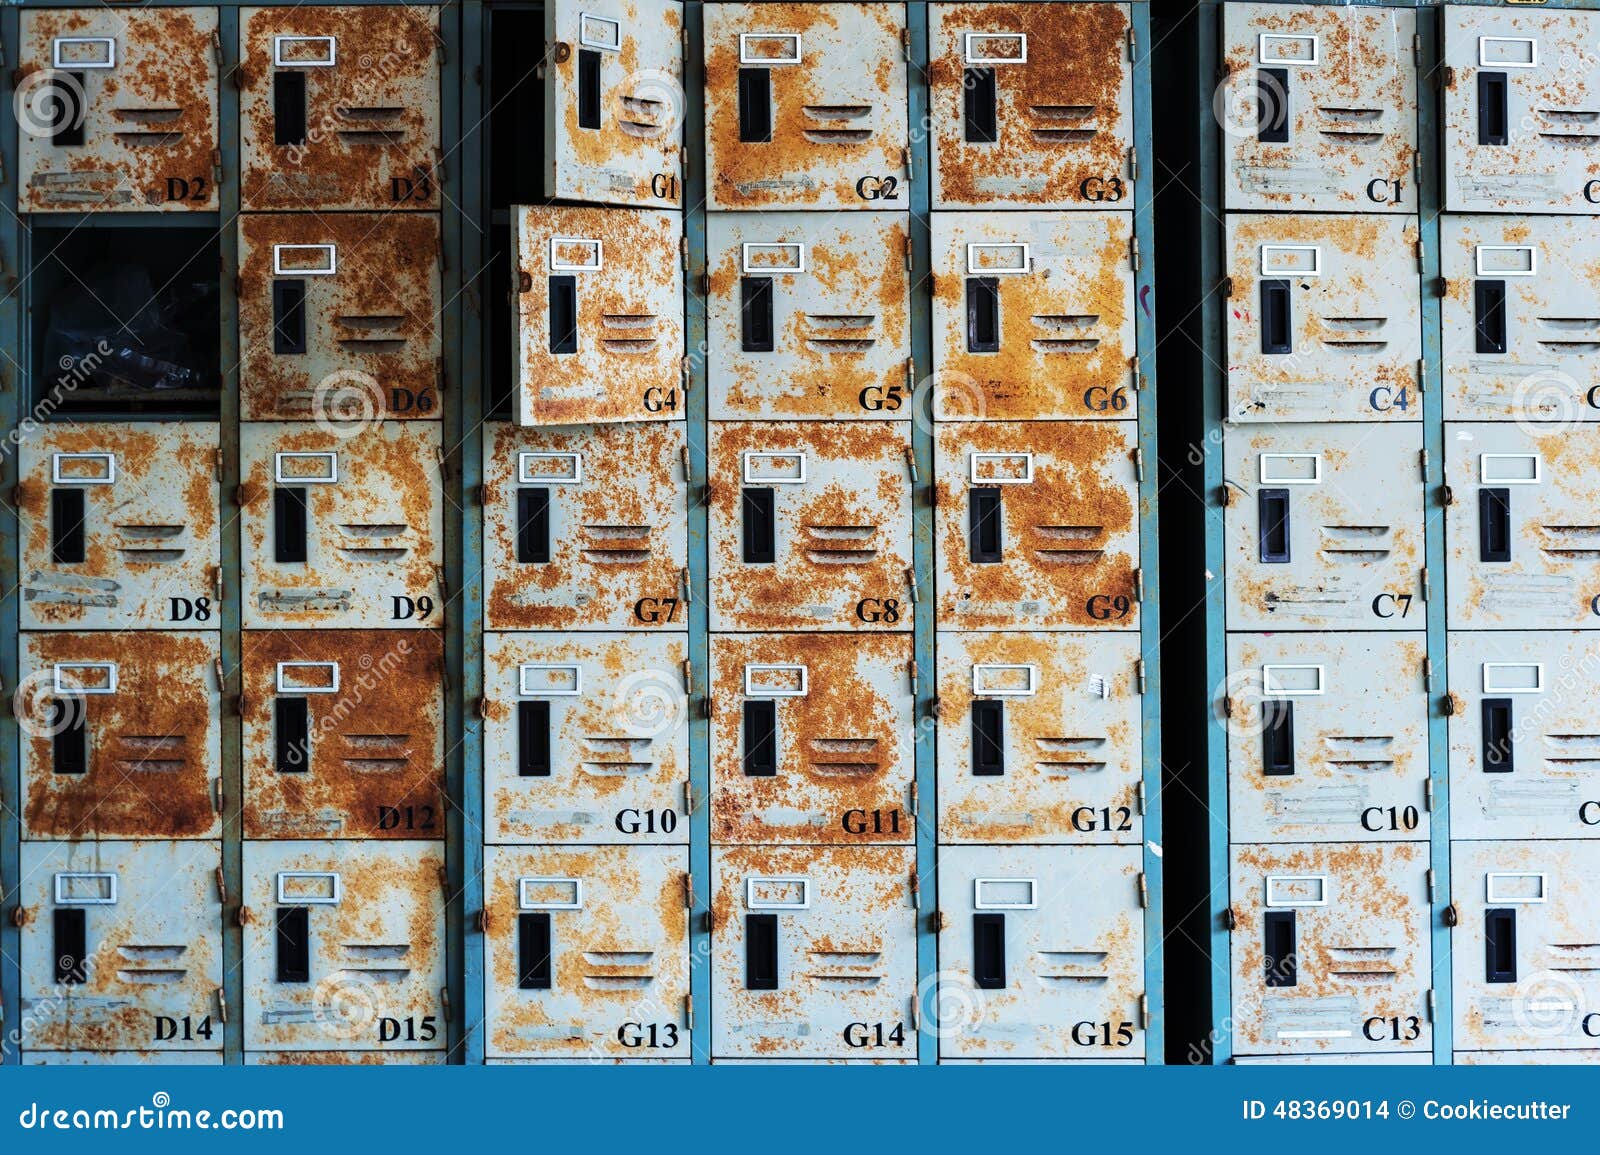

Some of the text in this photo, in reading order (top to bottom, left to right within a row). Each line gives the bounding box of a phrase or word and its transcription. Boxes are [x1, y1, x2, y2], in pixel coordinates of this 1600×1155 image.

[166, 177, 208, 202] D2
[390, 178, 431, 202] D3
[652, 174, 676, 199] G1
[856, 177, 899, 200] G2
[1080, 177, 1123, 203] G3
[1367, 178, 1404, 204] C1
[392, 388, 433, 413] D6
[643, 388, 676, 412] G4
[859, 387, 903, 411] G5
[1084, 386, 1127, 411] G6
[1369, 386, 1409, 411] C4
[169, 598, 211, 621] D8
[391, 596, 433, 620] D9
[634, 598, 678, 622] G7
[856, 598, 899, 623] G8
[1086, 595, 1130, 620] G9
[1372, 594, 1412, 618] C7
[378, 806, 436, 829] D12
[615, 809, 677, 834] G10
[842, 809, 899, 834] G11
[1071, 807, 1133, 832] G12
[1360, 806, 1419, 832] C10
[155, 1016, 213, 1040] D14
[378, 1017, 438, 1042] D15
[617, 1022, 679, 1048] G13
[843, 1022, 905, 1047] G14
[1071, 1021, 1134, 1047] G15
[1363, 1016, 1421, 1042] C13
